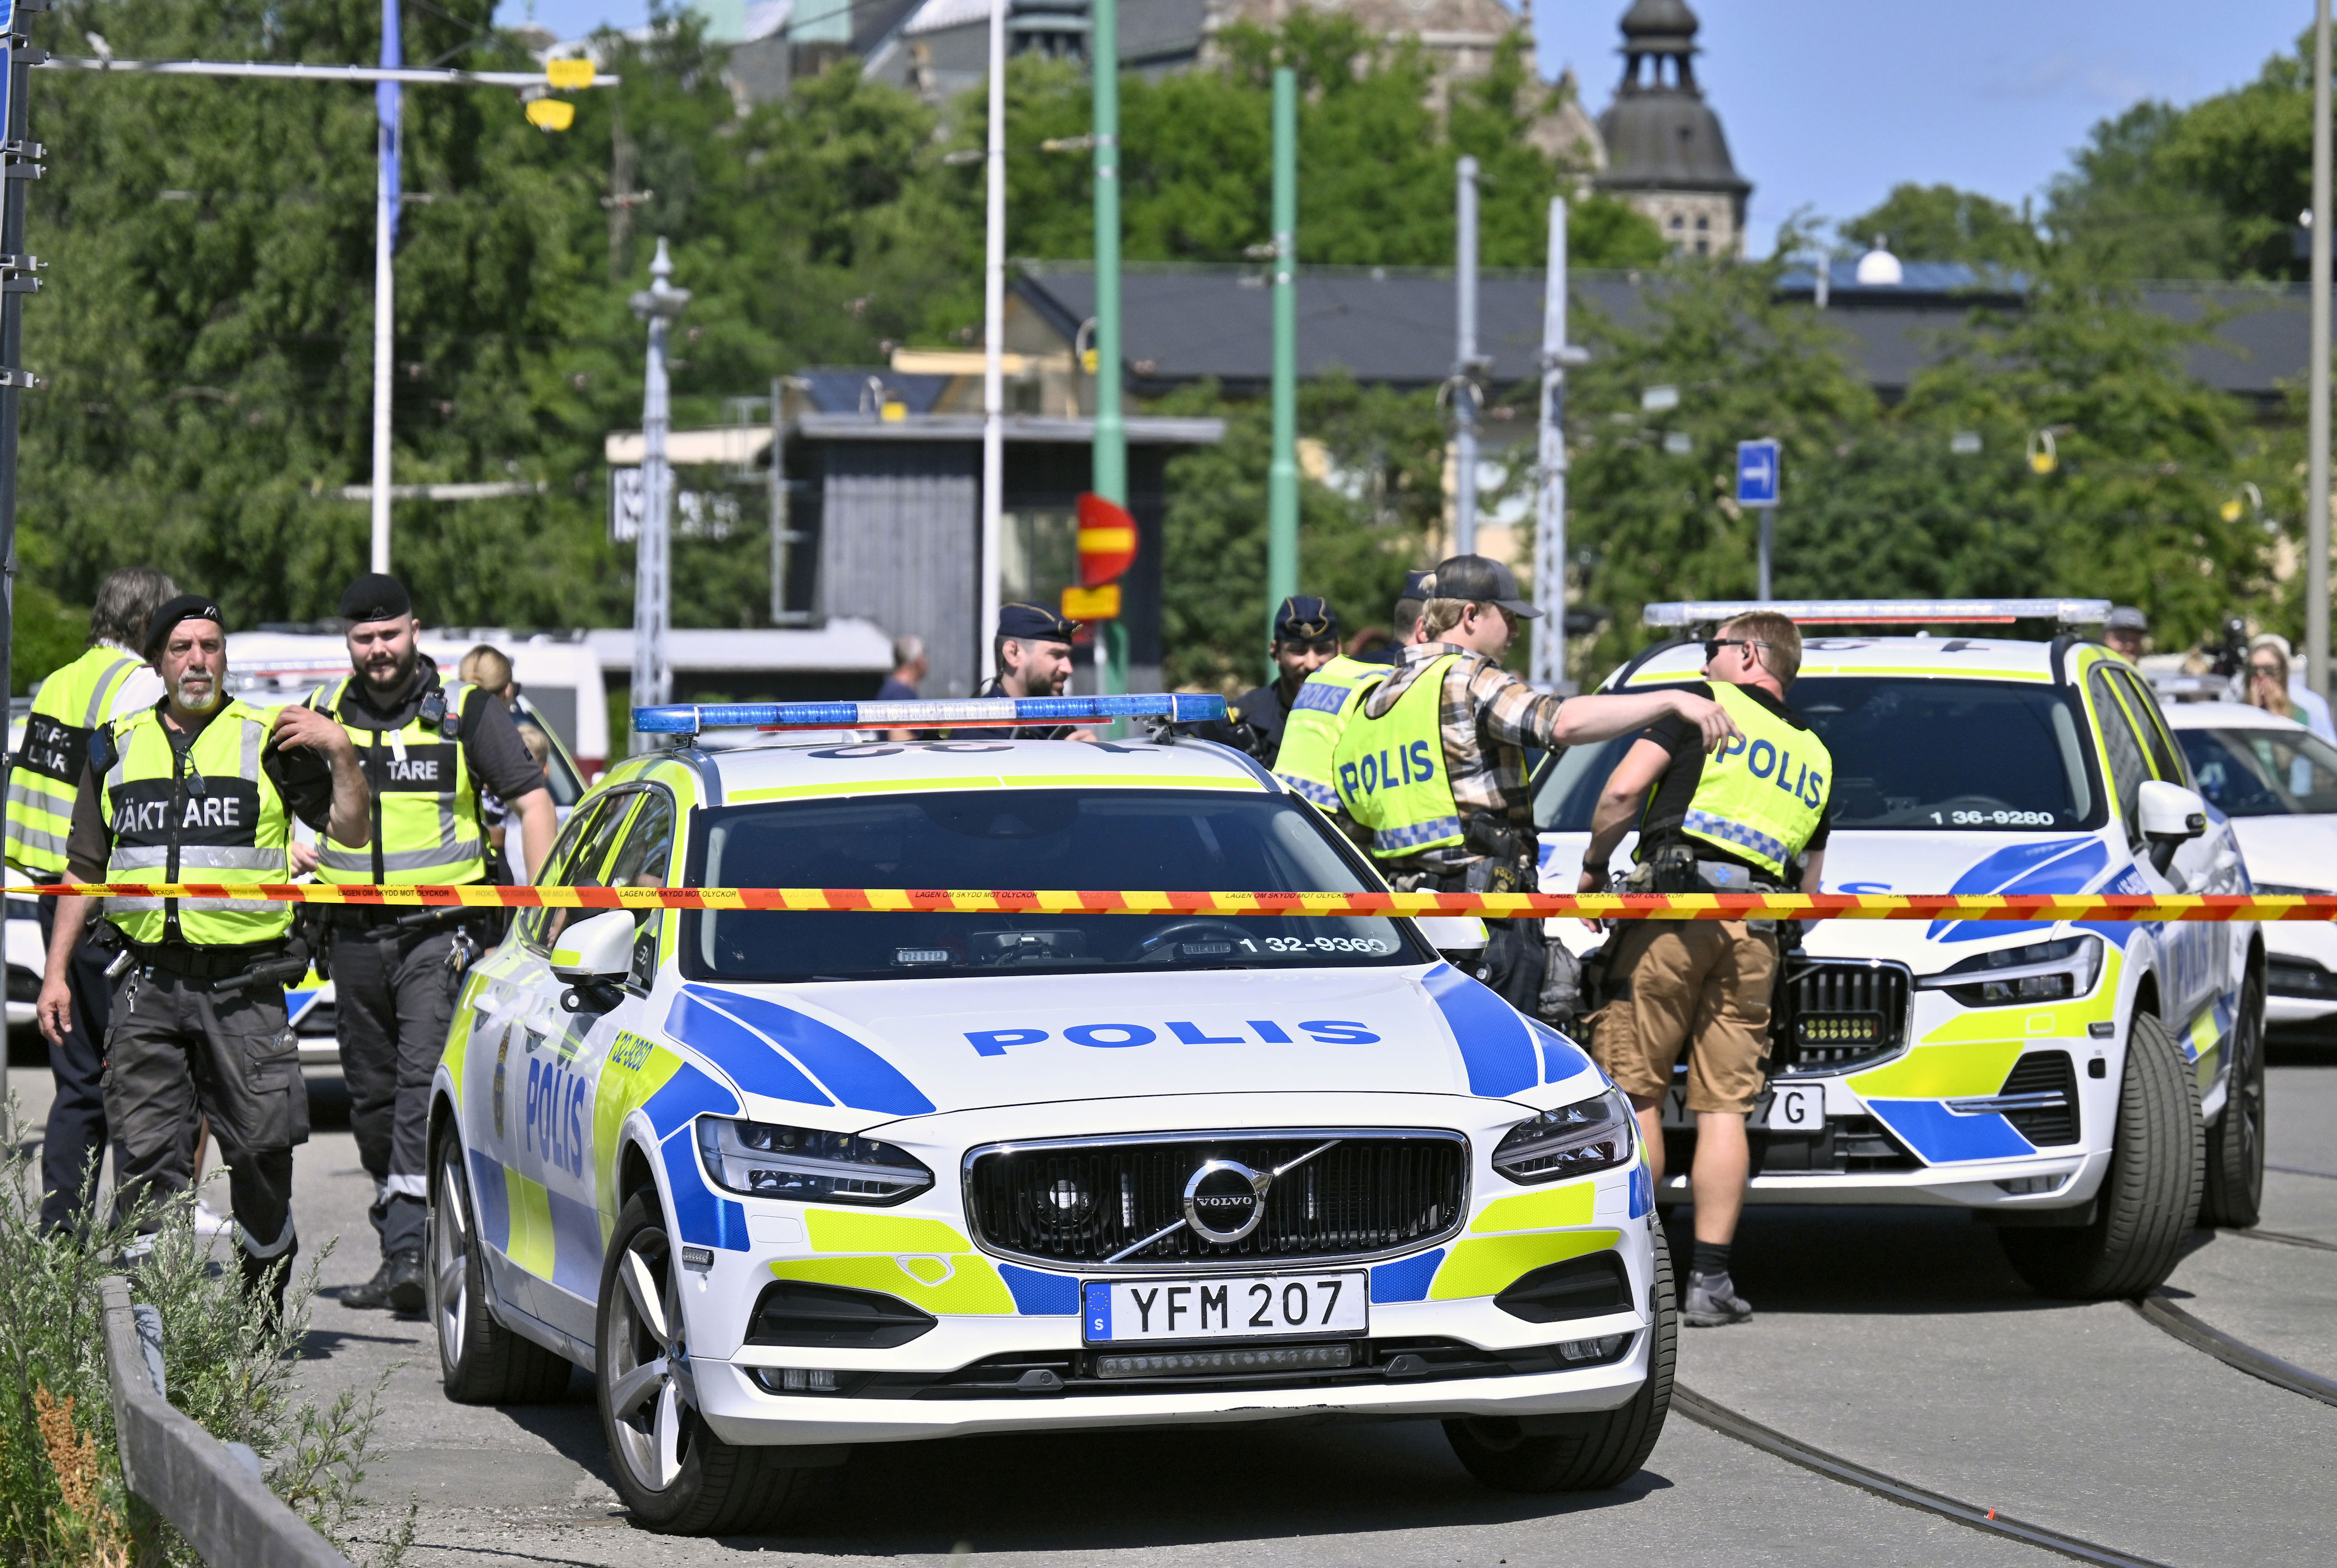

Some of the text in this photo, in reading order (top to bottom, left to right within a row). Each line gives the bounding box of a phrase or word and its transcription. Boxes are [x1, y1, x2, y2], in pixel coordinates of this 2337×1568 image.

[1293, 683, 1345, 711] POLIS
[1339, 740, 1434, 803] POLIS
[1716, 731, 1823, 809] POLIS
[1930, 810, 2054, 826] 1 36-9280
[1239, 936, 1389, 953] 1 32-9360
[612, 1033, 654, 1072] 32-9360
[963, 1020, 1381, 1057] POLIS
[526, 1057, 586, 1179] POLIS
[1197, 1196, 1252, 1207] VOLVO
[1094, 1280, 1343, 1332] S YFM 207
